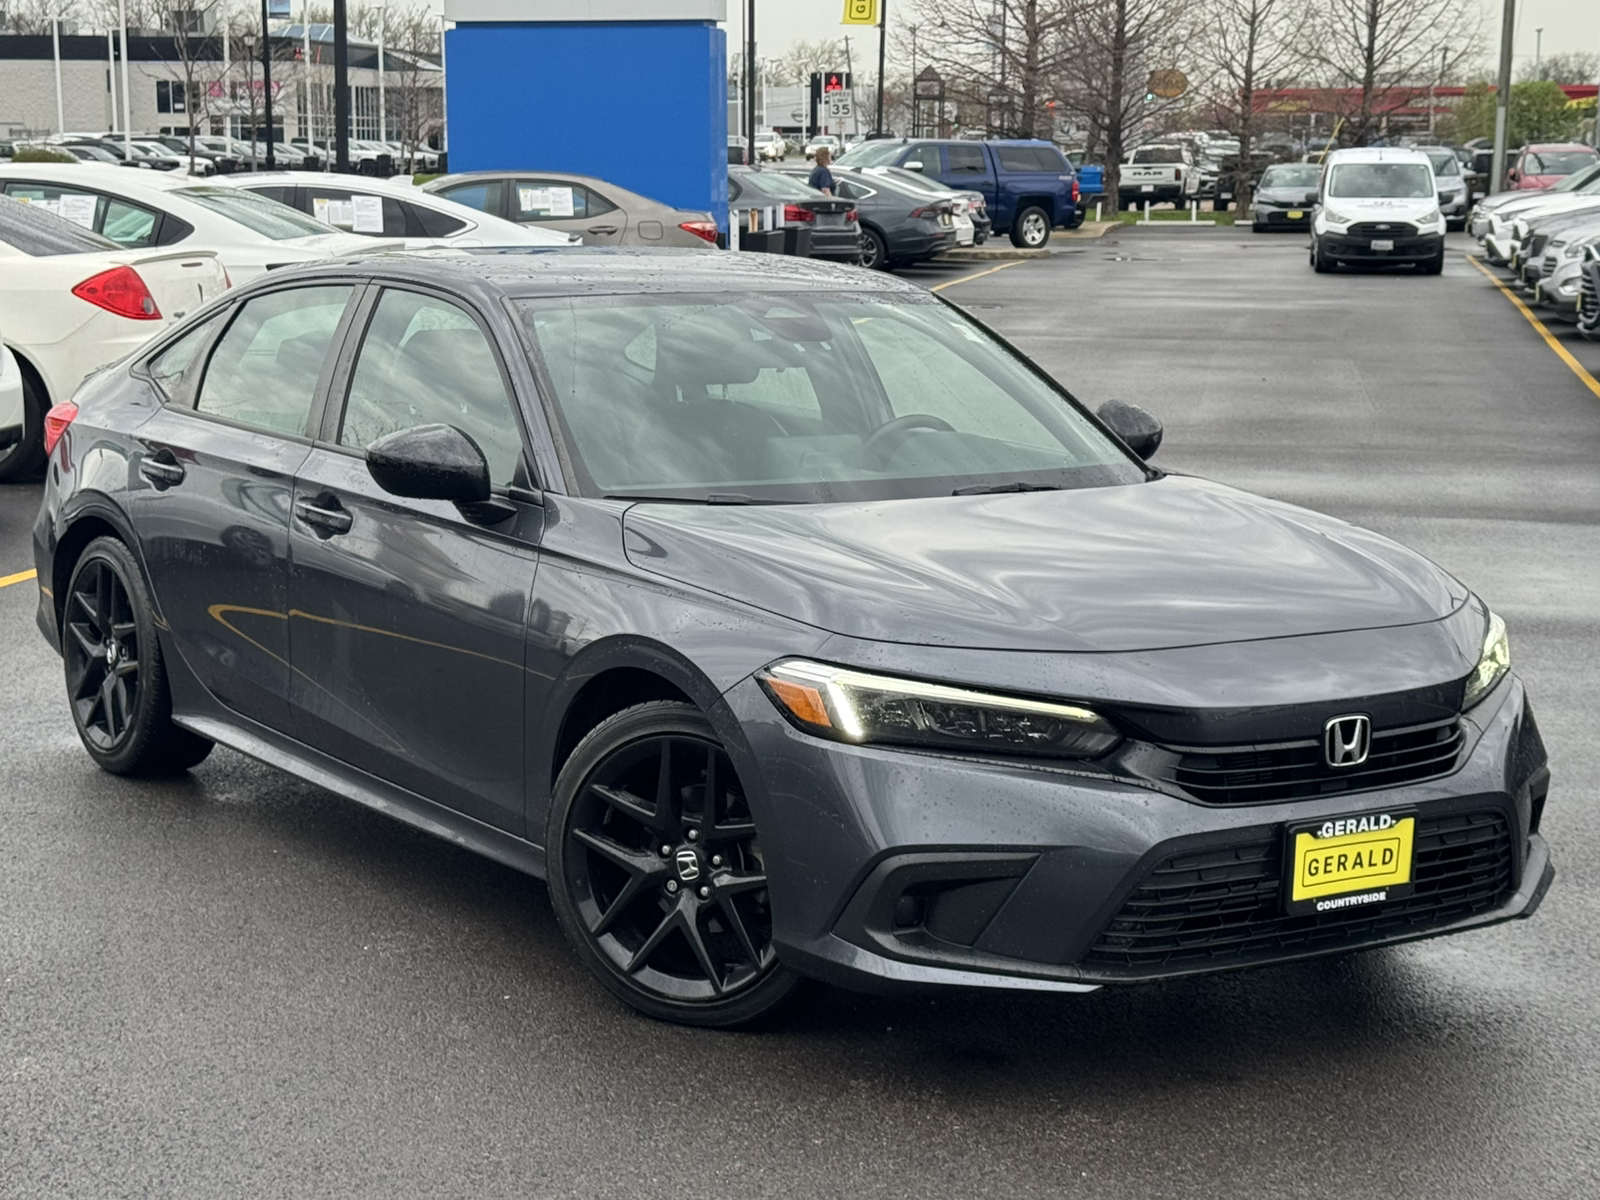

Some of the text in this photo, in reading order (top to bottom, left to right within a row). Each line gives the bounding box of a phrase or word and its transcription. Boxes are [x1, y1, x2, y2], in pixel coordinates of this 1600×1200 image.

[832, 104, 850, 115] 35
[1322, 814, 1392, 838] GERALD
[1308, 848, 1394, 877] GERALD
[1316, 891, 1387, 911] COUNTRYSIDE
